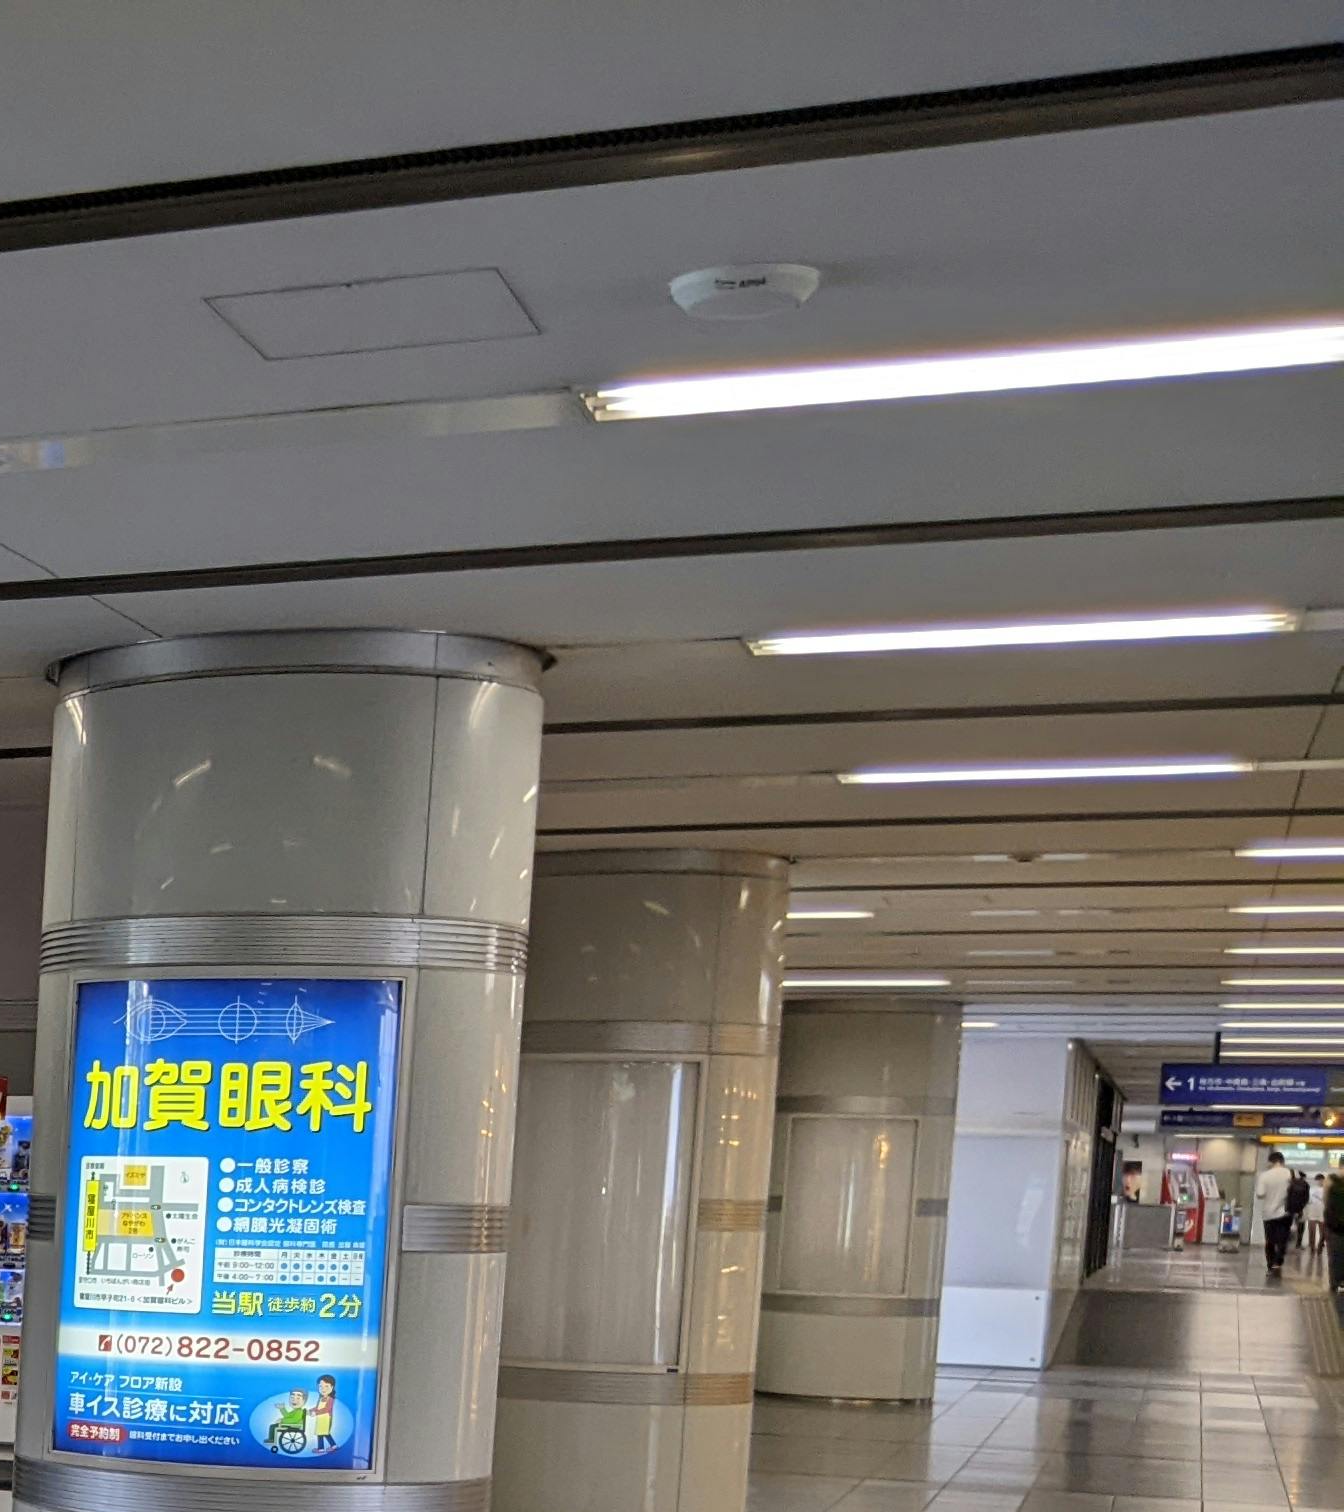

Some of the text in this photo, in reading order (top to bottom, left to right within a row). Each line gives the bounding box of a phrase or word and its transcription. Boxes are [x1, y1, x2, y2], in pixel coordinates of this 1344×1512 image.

[1187, 1077, 1195, 1091] 1
[83, 1058, 372, 1133] 加賀眼科
[237, 1157, 309, 1174] 一般診察
[235, 1177, 327, 1194] 成人病検診
[234, 1198, 367, 1215] コンタクトレンズ検査
[212, 1290, 363, 1319] 当駅 徒歩約 2分
[116, 1333, 321, 1362] (072)822-0852
[70, 1371, 183, 1392] アイ・ケア フロア新設
[68, 1391, 240, 1426] 車イス診療に対応
[70, 1423, 120, 1441] 完全予約制
